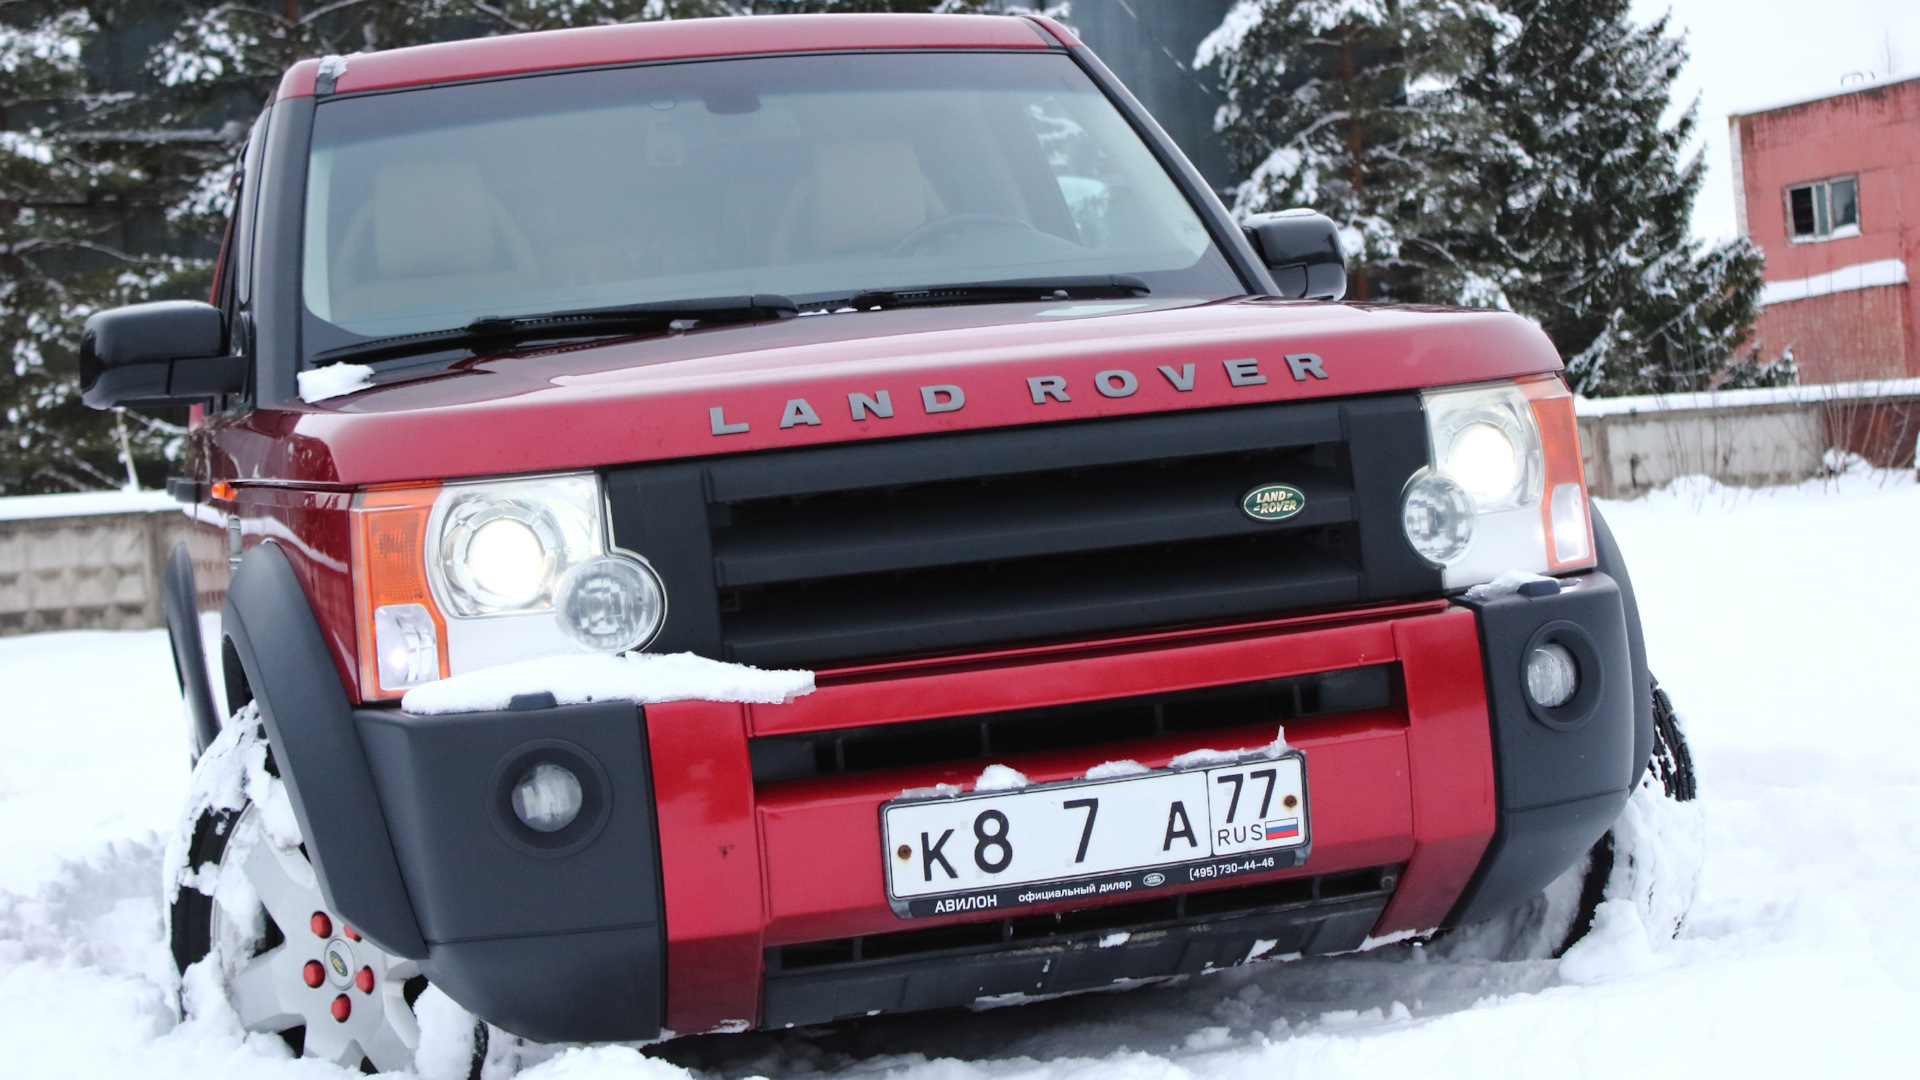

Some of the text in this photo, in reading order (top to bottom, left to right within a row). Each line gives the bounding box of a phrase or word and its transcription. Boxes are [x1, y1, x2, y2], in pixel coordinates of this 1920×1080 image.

[708, 352, 1329, 436] LAND ROVER
[1256, 490, 1287, 504] LAND
[1260, 499, 1297, 514] ROVER
[1216, 768, 1277, 824] 77
[1217, 823, 1263, 847] RUS
[1189, 857, 1275, 881] (495) 730-44-46
[934, 880, 1132, 914] АВИЛОН официальный дилер
